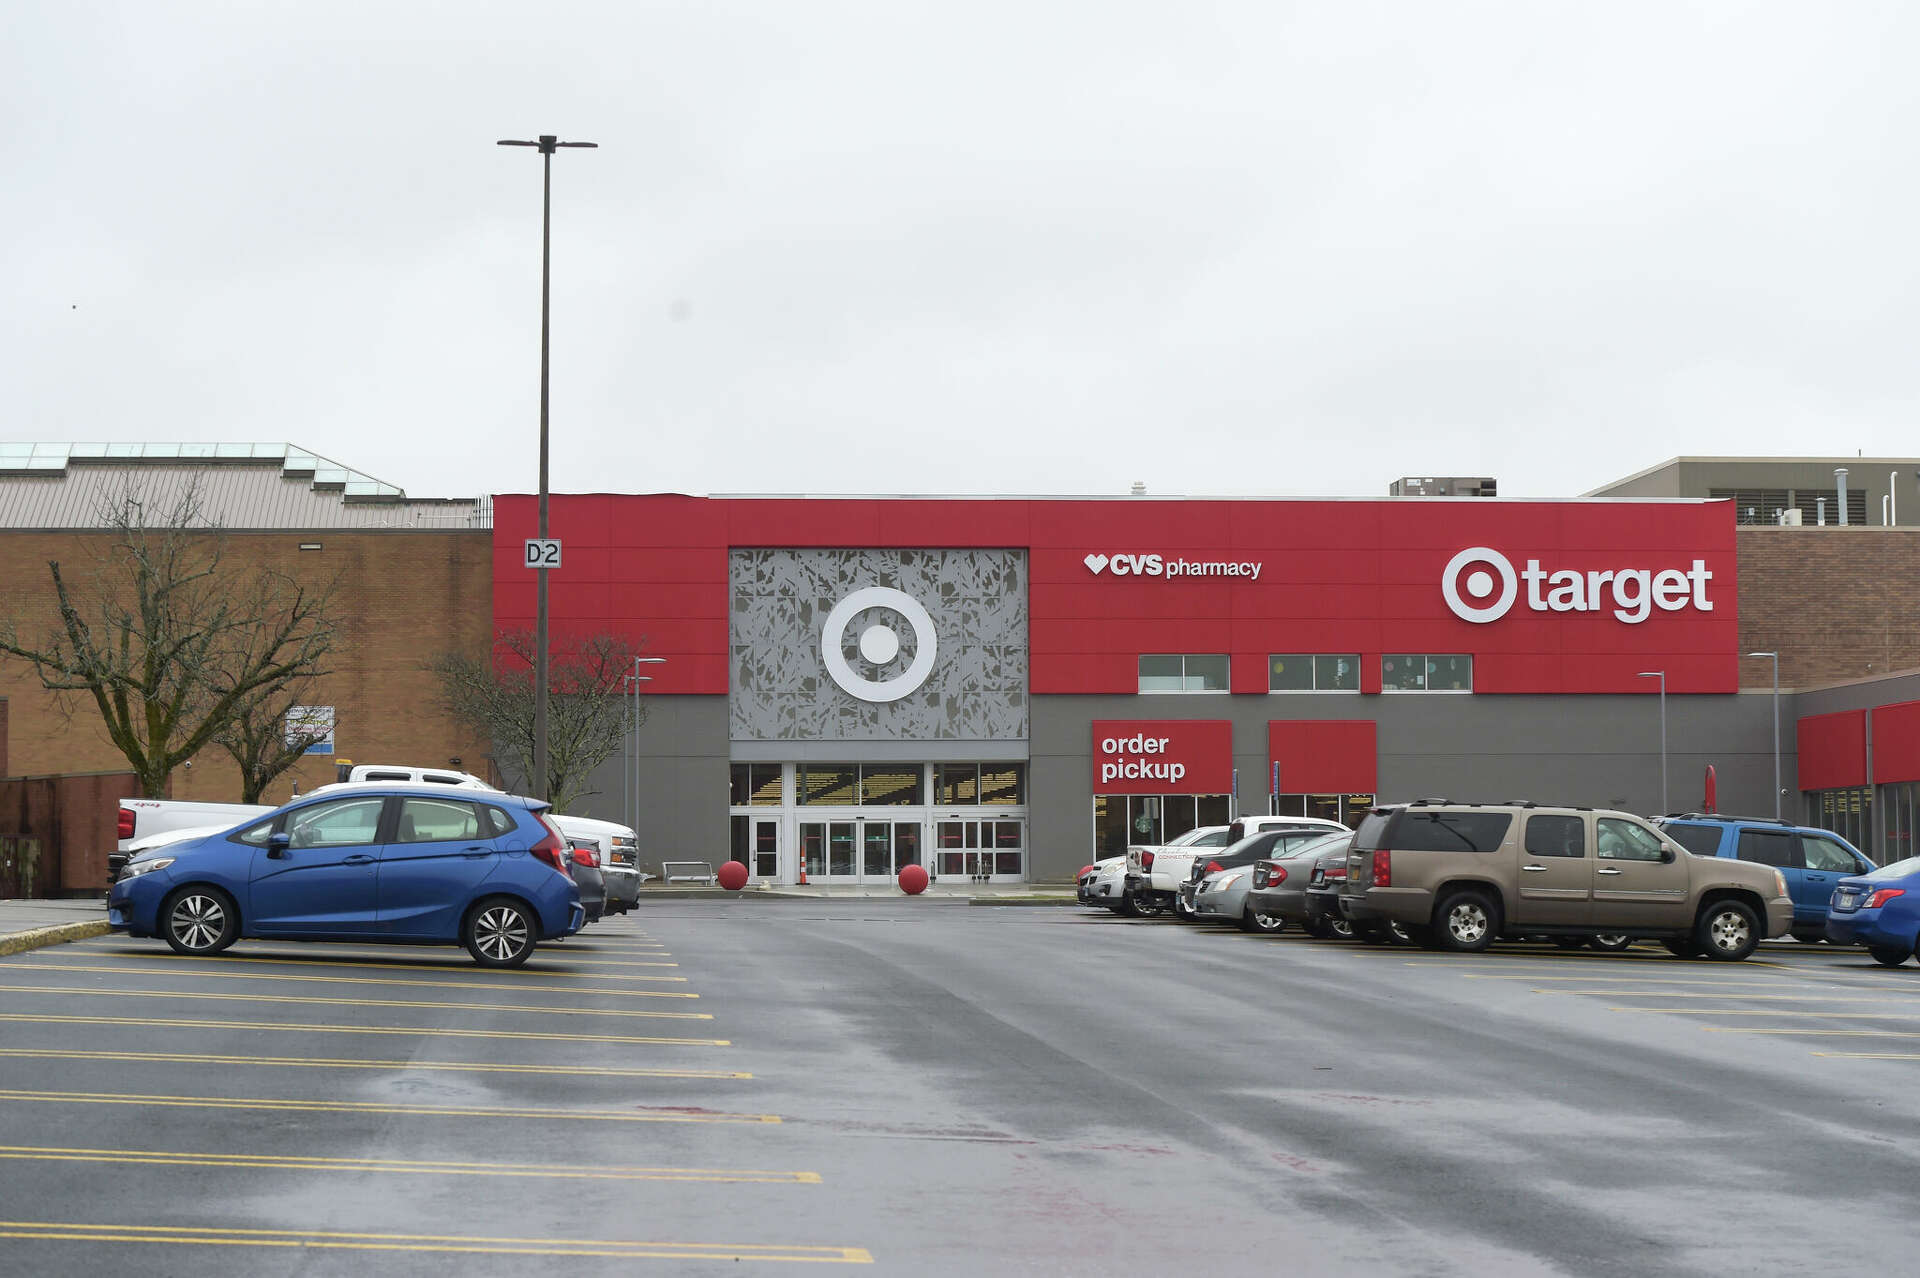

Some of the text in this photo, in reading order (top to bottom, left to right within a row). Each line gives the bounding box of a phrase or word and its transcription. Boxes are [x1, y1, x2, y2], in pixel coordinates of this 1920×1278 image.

[1109, 553, 1262, 579] CVS pharmacy
[1521, 559, 1713, 624] target
[1101, 733, 1169, 753] order
[1102, 758, 1186, 783] pickup
